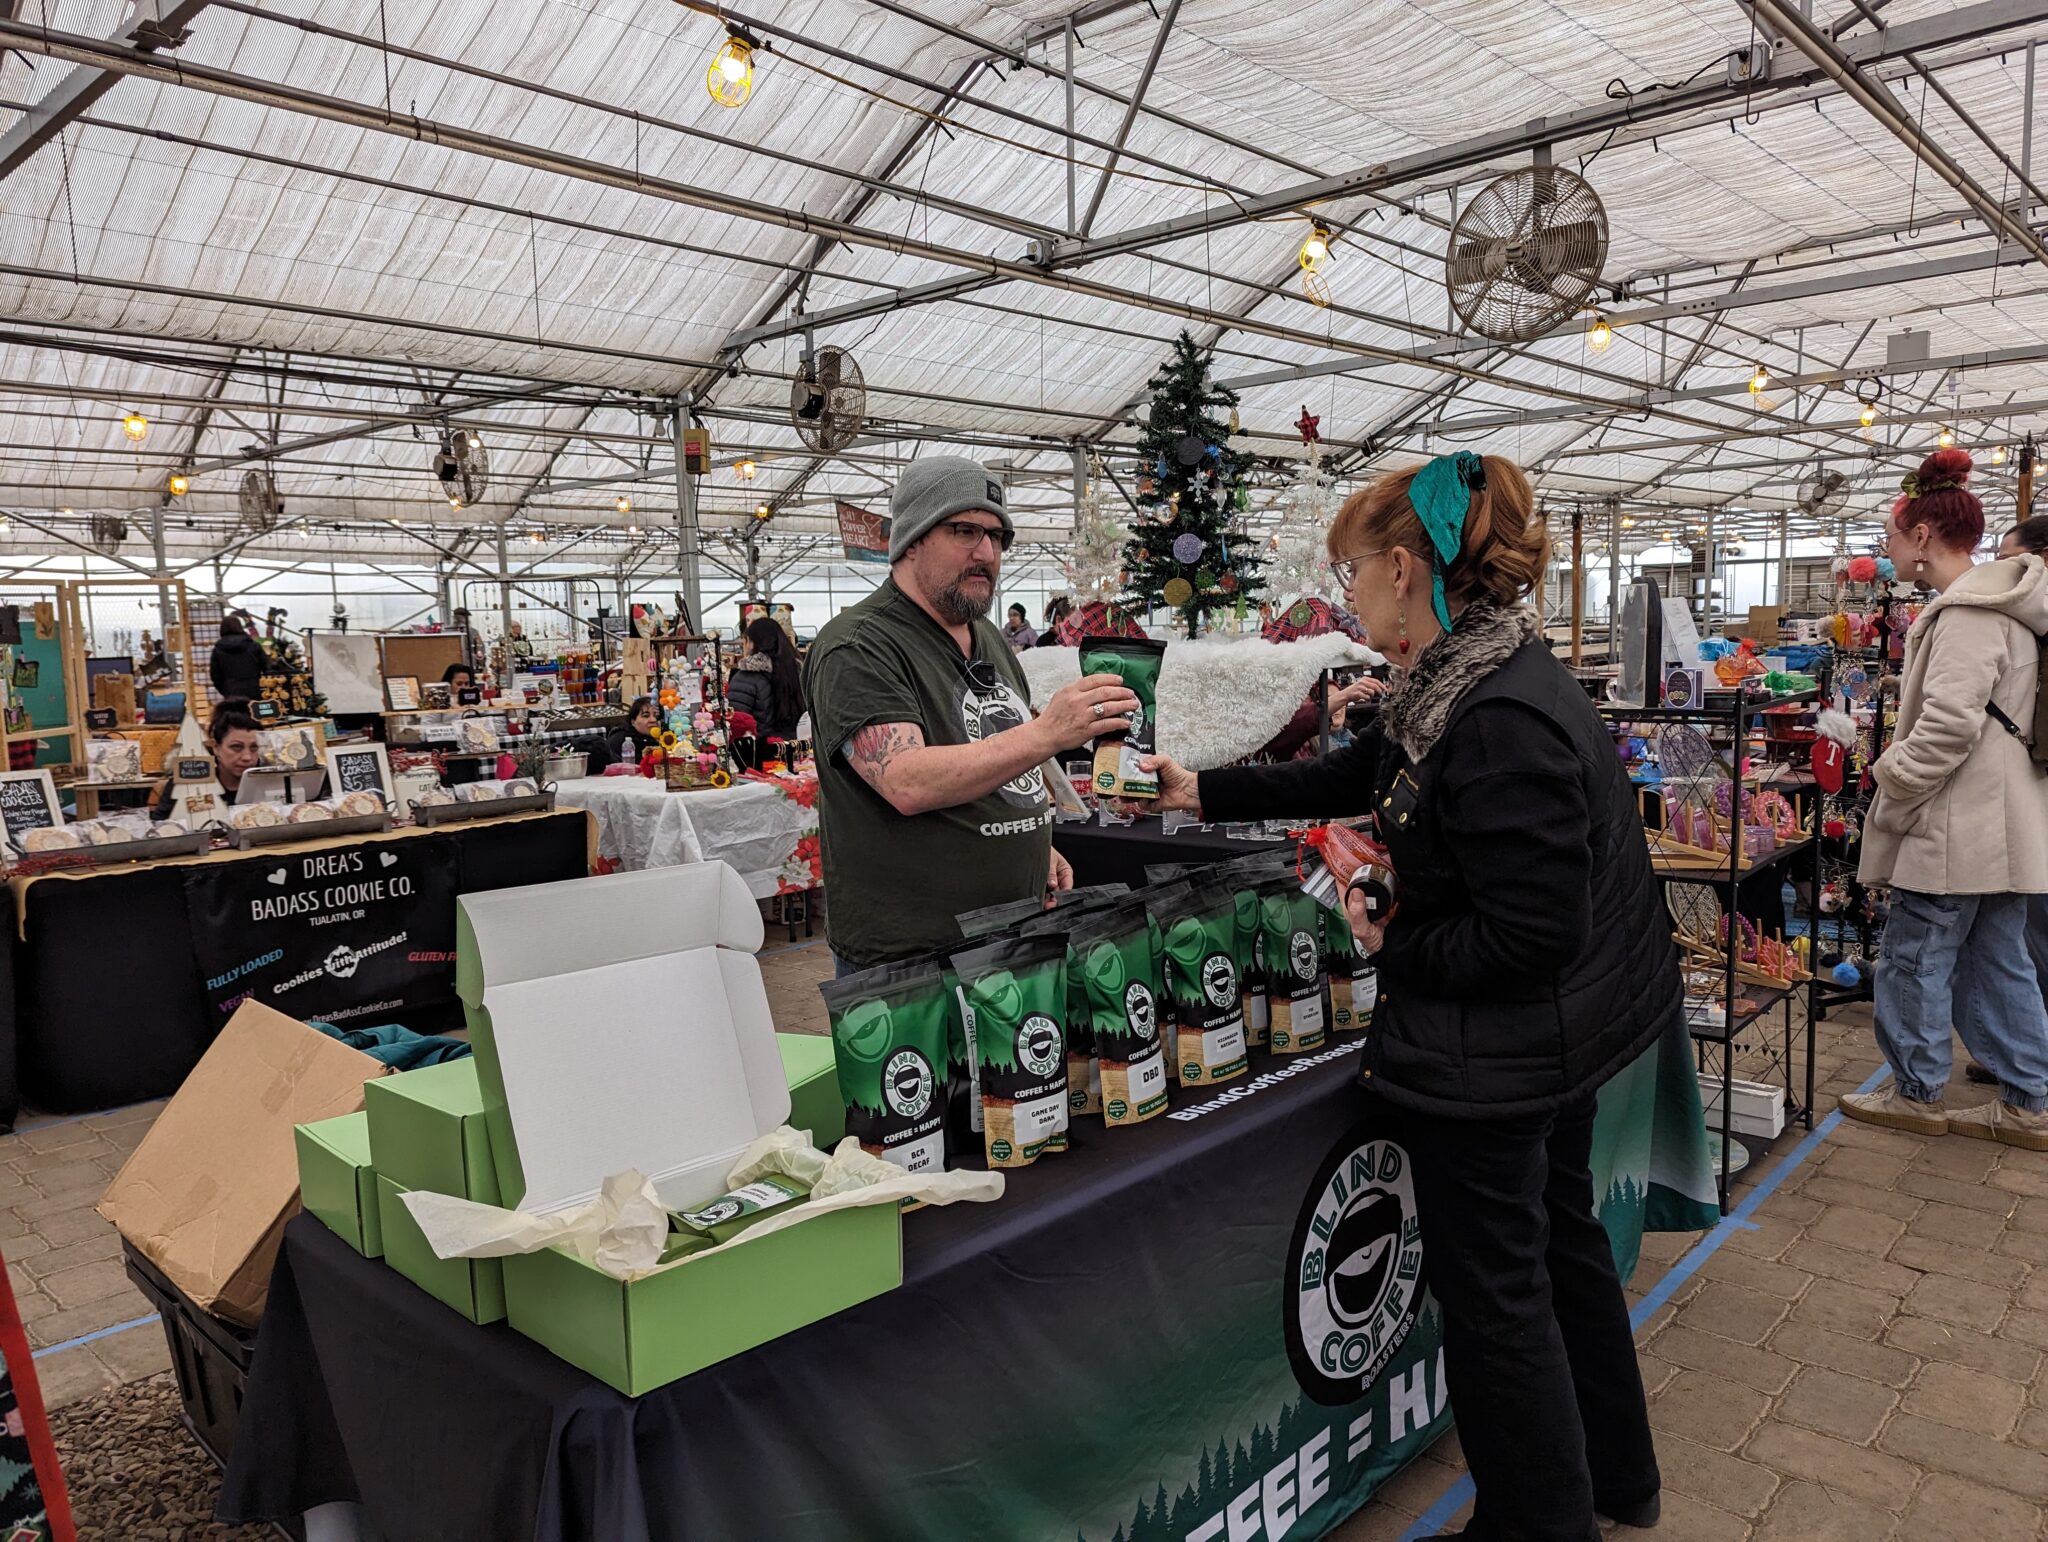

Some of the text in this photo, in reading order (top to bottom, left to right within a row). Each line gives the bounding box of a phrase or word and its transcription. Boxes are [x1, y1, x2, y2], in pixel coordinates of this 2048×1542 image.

[843, 532, 868, 547] HEART
[340, 754, 374, 767] BADASS
[1825, 742, 1841, 767] T
[341, 764, 377, 777] COOKIES
[343, 775, 363, 792] $5
[1, 794, 43, 808] COOKIES
[980, 817, 1036, 836] COFFEE
[303, 852, 364, 879] DREA'S
[252, 876, 416, 921] BADASS COOKIE CO.
[309, 909, 366, 927] TUALATIN, OR
[1292, 932, 1310, 958] BLIND
[273, 931, 408, 994] Cookies with Attitude!
[408, 952, 446, 962] GLUTEN
[206, 948, 284, 990] FULLY LOADED
[1204, 958, 1228, 986] BLIND
[1352, 968, 1368, 977] COFFEE
[1214, 973, 1236, 1006] COFFEE
[1291, 988, 1309, 998] COFFEE
[1127, 984, 1144, 1016] BLIND
[966, 1014, 977, 1046] COFFEE
[1204, 1016, 1226, 1028] COFFEE
[1020, 1018, 1050, 1050] BLIND
[1128, 1047, 1149, 1060] COFFEE
[1220, 1040, 1237, 1049] NATURAL
[1028, 1036, 1061, 1074] COFFEE
[886, 1052, 918, 1090] BLIND
[1142, 1066, 1159, 1083] DBD
[896, 1072, 931, 1114] COFFEE
[1014, 1084, 1043, 1098] COFFEE
[1031, 1104, 1060, 1118] GAME DAY
[1038, 1115, 1056, 1125] DARK
[884, 1128, 913, 1144] COFFEE
[919, 1116, 941, 1132] HAPPY
[911, 1148, 926, 1159] BCR
[908, 1158, 930, 1172] DECAF
[1301, 1144, 1402, 1292] BLIND
[1320, 1216, 1420, 1372] COFFEE
[1362, 1311, 1414, 1390] ROASTERS
